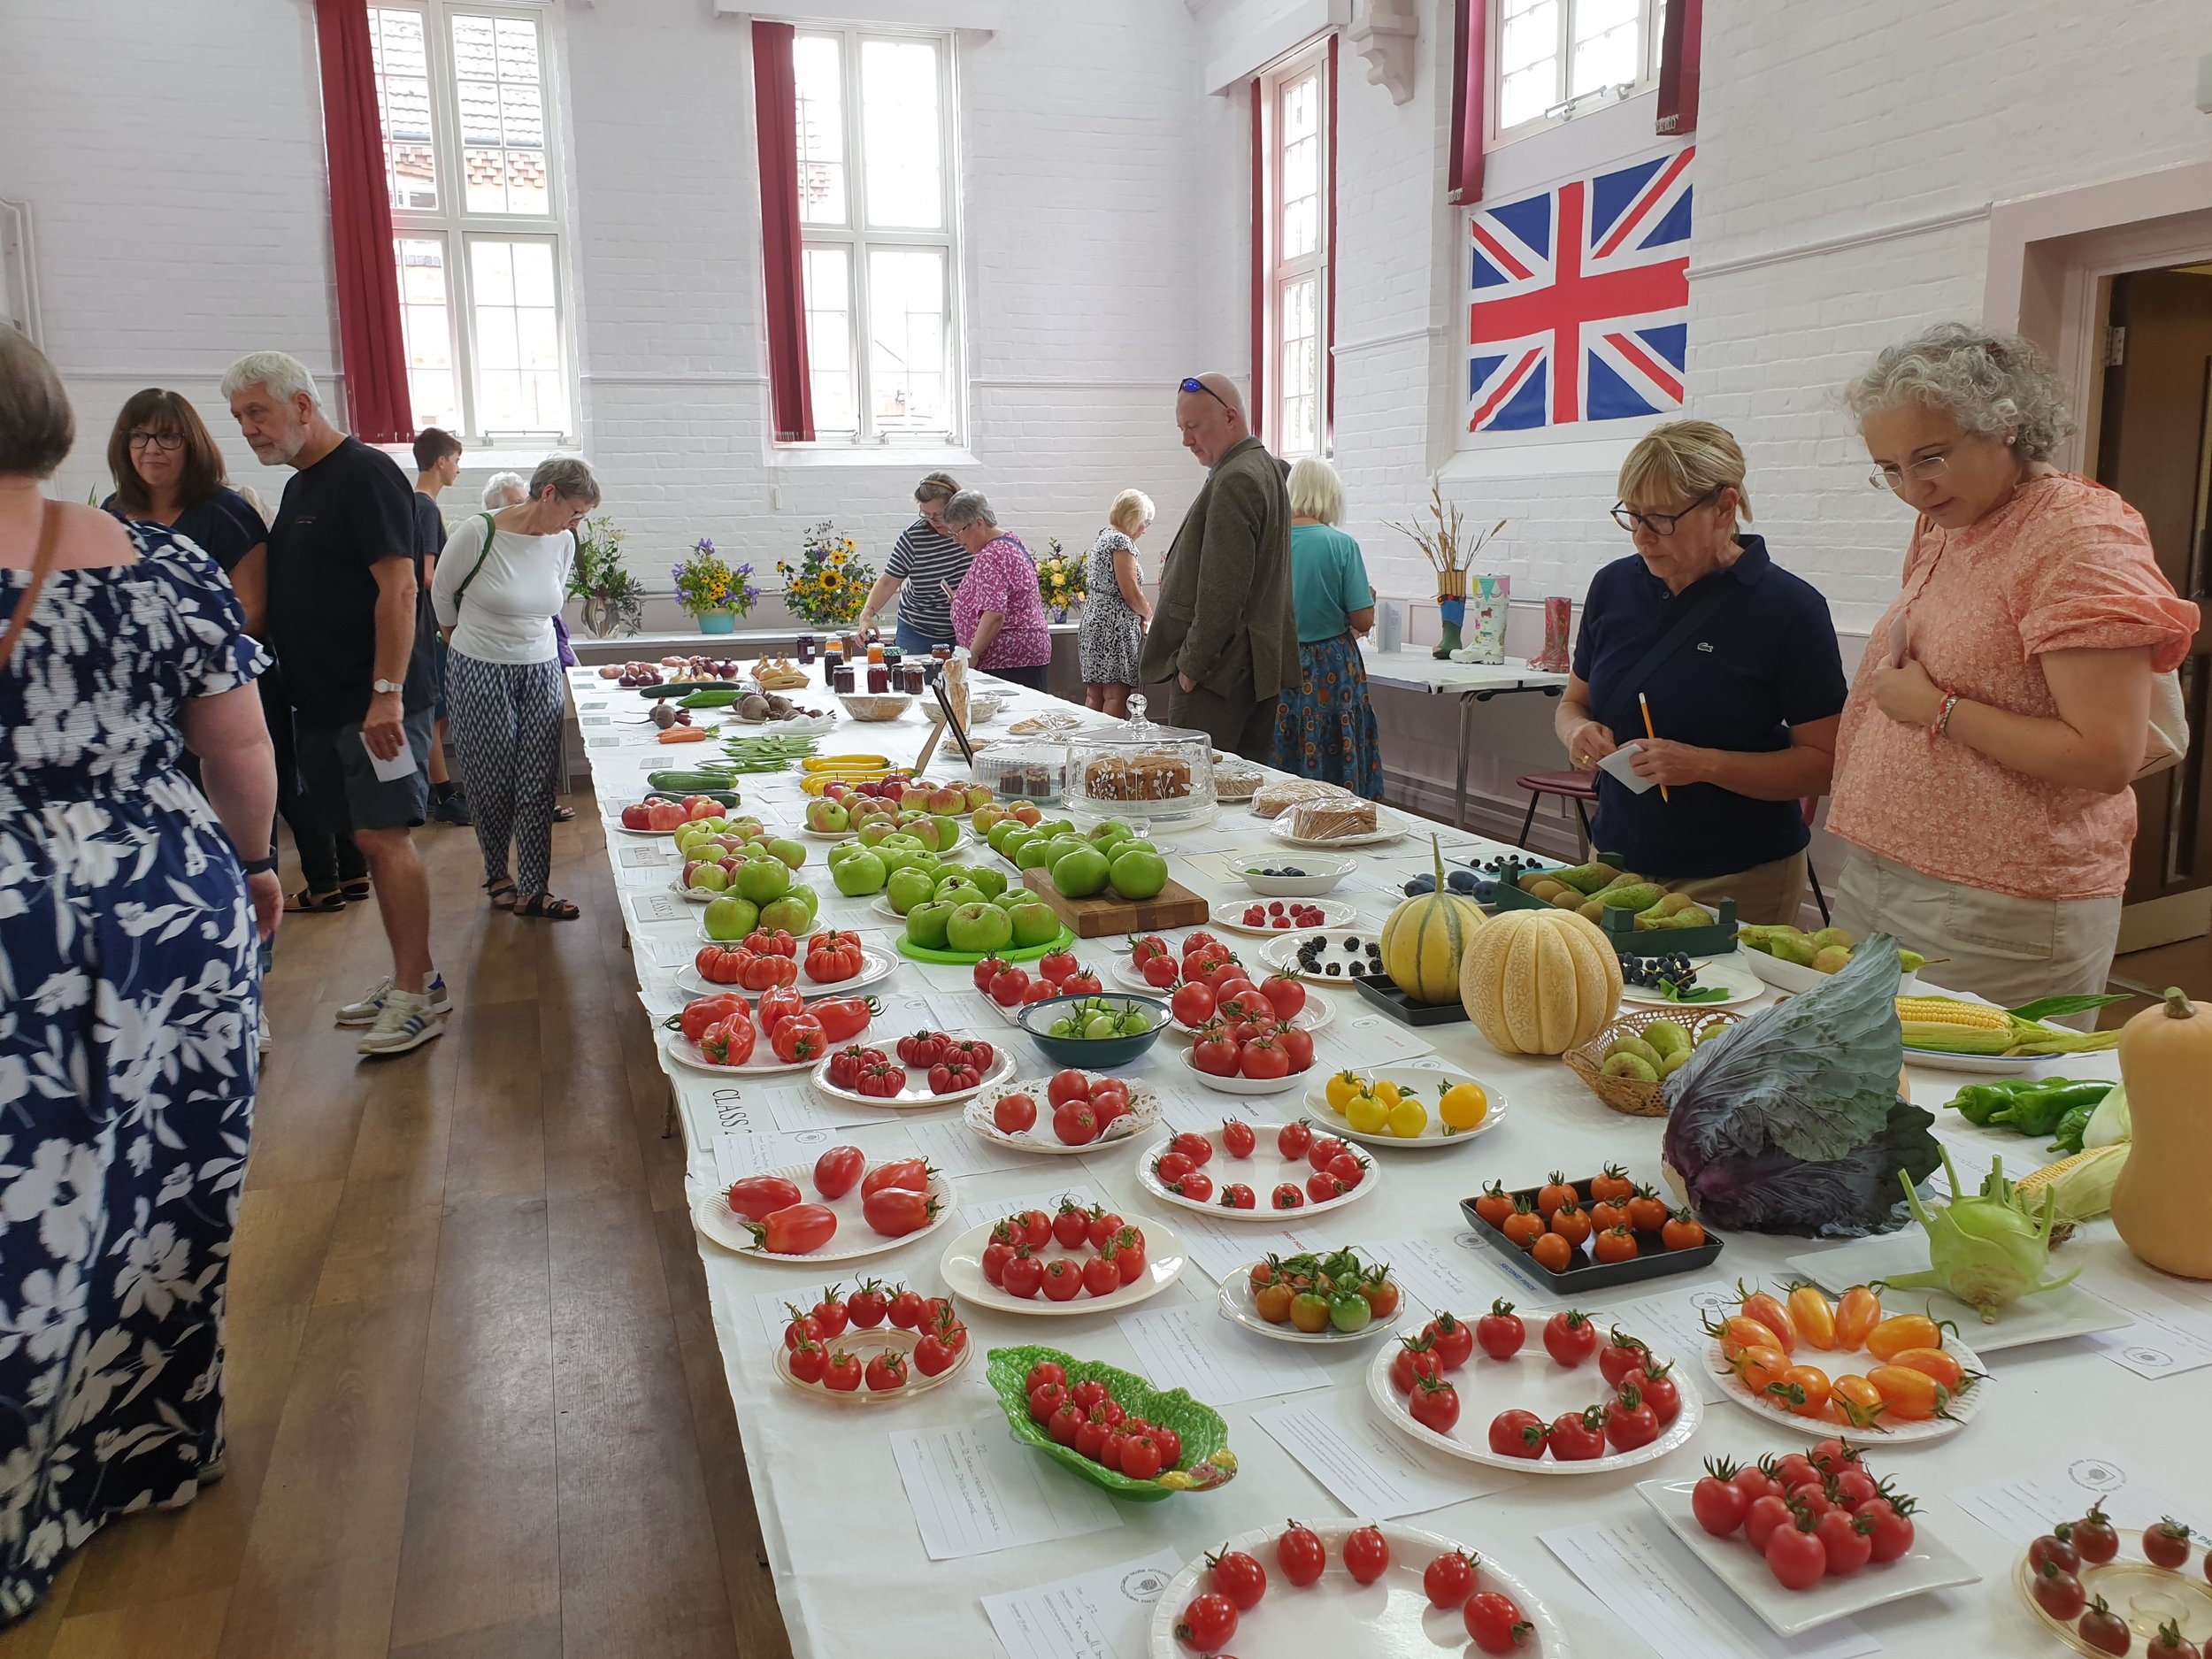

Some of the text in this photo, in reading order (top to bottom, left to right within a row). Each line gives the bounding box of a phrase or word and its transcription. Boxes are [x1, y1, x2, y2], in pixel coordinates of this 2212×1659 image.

[634, 847, 652, 860] CLASS
[649, 895, 672, 912] CLASS
[712, 1089, 749, 1127] CLASS
[975, 1444, 987, 1454] 22
